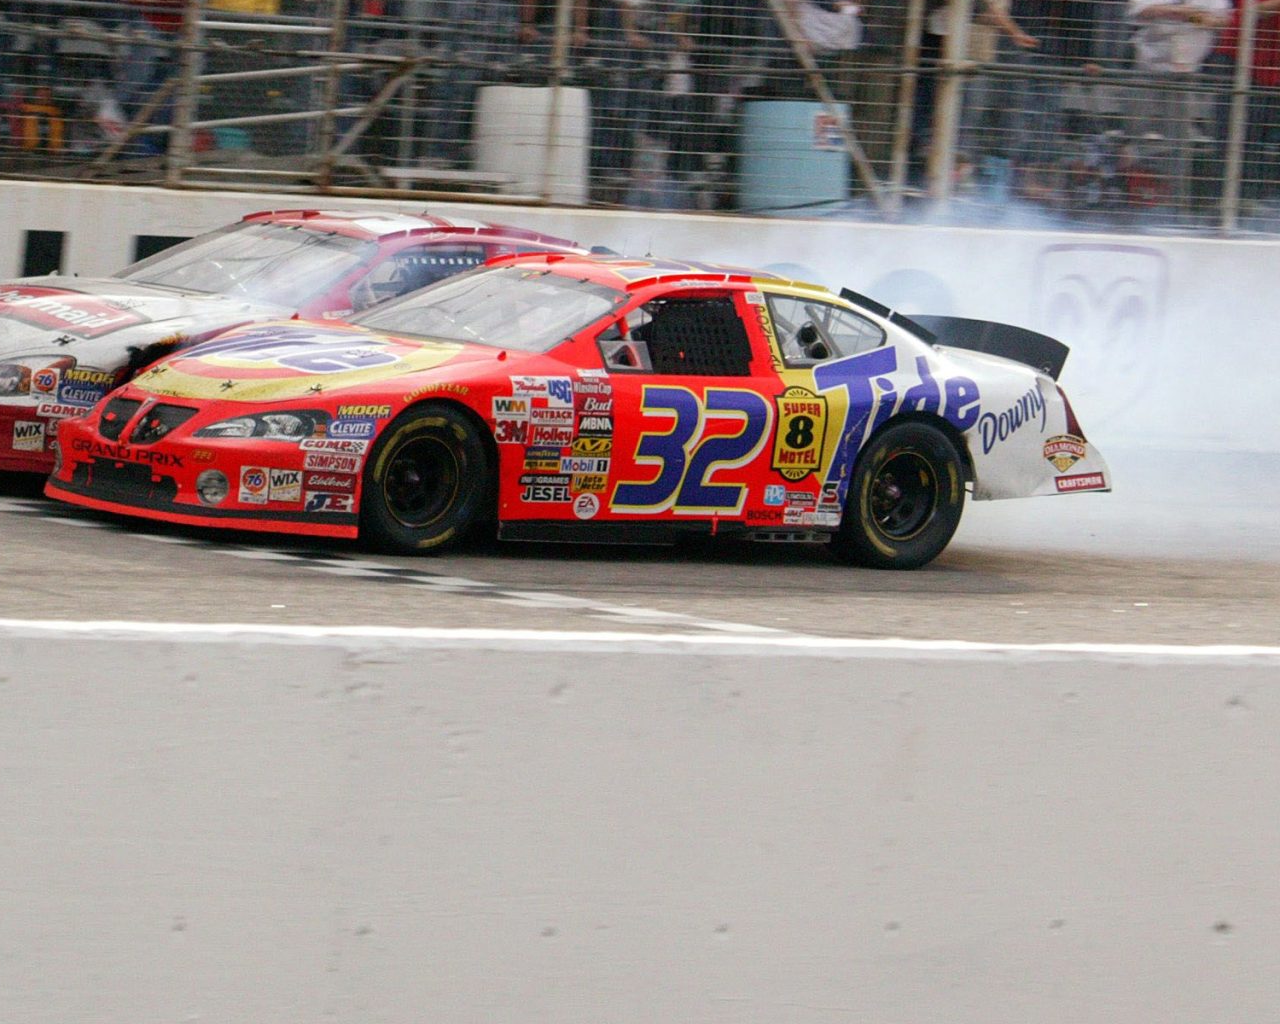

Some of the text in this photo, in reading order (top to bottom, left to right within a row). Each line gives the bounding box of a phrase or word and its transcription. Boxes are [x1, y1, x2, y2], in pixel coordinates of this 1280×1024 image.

[38, 374, 53, 387] 76
[64, 368, 115, 384] MOOG
[403, 383, 469, 403] GOODYEAR
[547, 379, 572, 404] USG
[574, 382, 612, 395] Winston Cup
[338, 404, 391, 416] MOOG
[495, 400, 526, 412] WM
[584, 397, 613, 411] Bud
[783, 402, 821, 417] SUPER
[532, 410, 573, 419] OUTBACK
[812, 345, 981, 484] Tide
[977, 382, 1047, 455] Downy
[15, 423, 43, 438] WIX
[329, 420, 371, 435] CLEVITE
[579, 417, 613, 430] MBNA
[495, 419, 529, 443] 3M
[535, 426, 572, 445] Holley
[785, 415, 814, 449] 8
[303, 440, 353, 450] COMP
[609, 384, 773, 516] 32
[1044, 441, 1085, 455] DIAMOND
[71, 438, 185, 467] GRAND PRIX
[779, 448, 816, 464] MOTEL
[308, 454, 357, 470] SIMPSON
[561, 459, 594, 471] Mobil
[597, 460, 608, 472] 1
[246, 474, 263, 486] 76
[271, 472, 300, 486] WIX
[1057, 475, 1103, 489] CRAFTSMAN
[522, 487, 572, 501] JESEL
[306, 493, 350, 512] JE
[578, 496, 595, 508] EA
[747, 510, 783, 519] BOSCH
